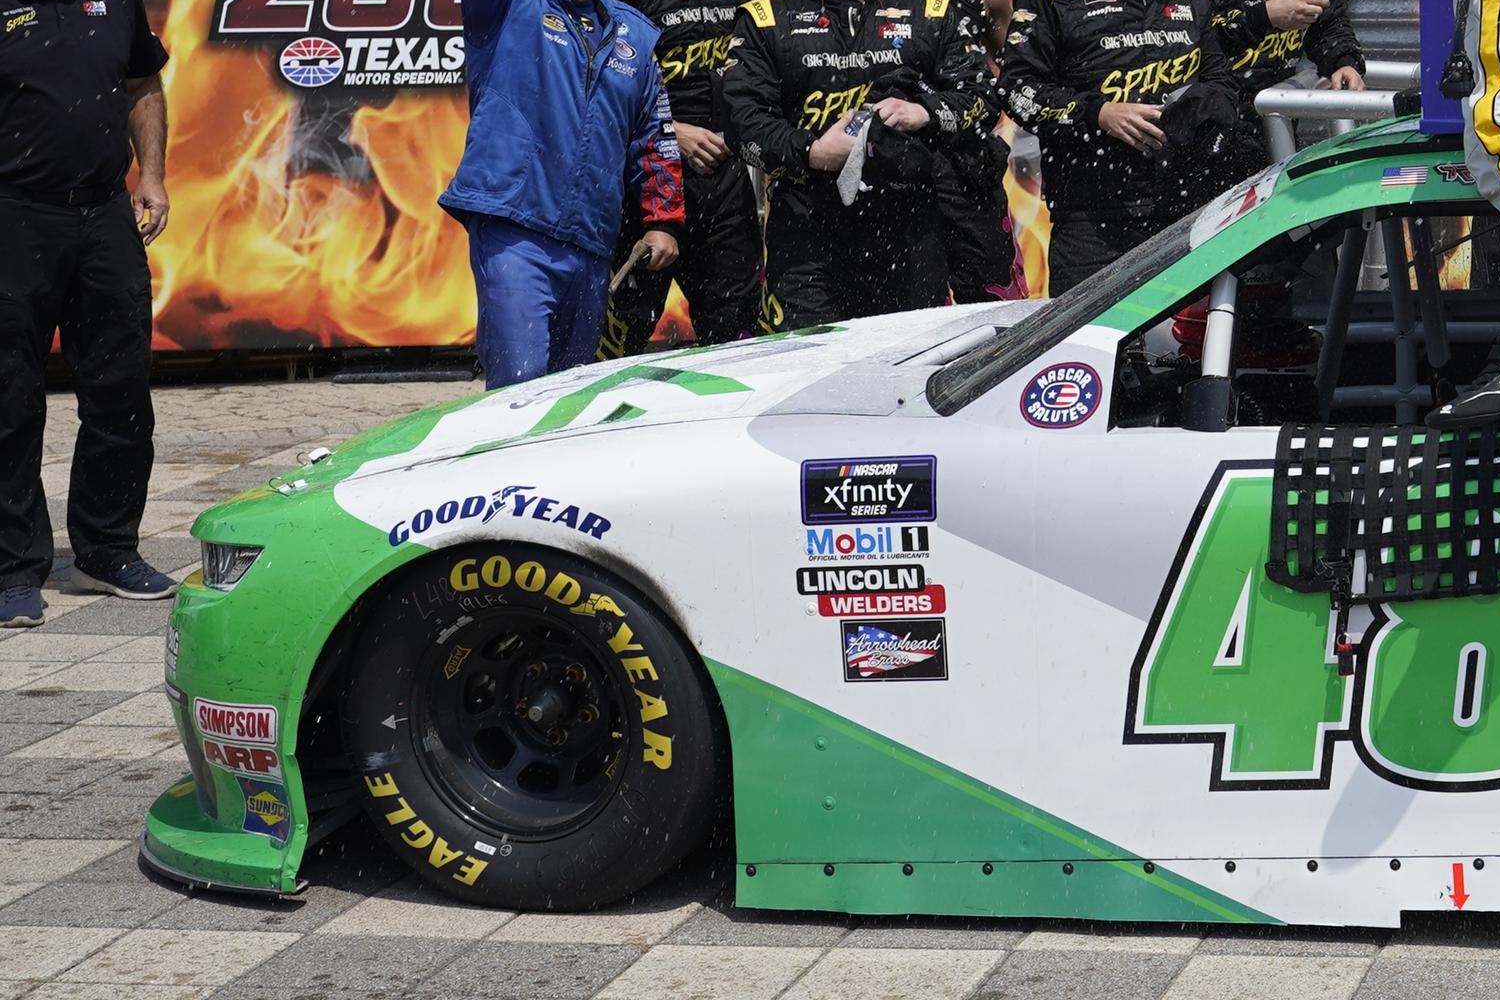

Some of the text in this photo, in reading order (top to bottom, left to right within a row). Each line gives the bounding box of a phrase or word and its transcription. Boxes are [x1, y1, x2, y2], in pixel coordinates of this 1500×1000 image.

[6, 9, 36, 32] SPIKED
[1100, 35, 1120, 49] BIG
[1119, 30, 1165, 48] MACHINE
[343, 37, 465, 70] TEXAS
[661, 34, 732, 83] SPIKE
[802, 50, 903, 70] BIG MACHINE VODKA
[344, 71, 460, 85] MOTOR SPEEDWAY
[1101, 48, 1201, 104] SPIKED
[1036, 367, 1091, 388] NASCAR
[1027, 402, 1088, 422] SALUTES
[853, 463, 898, 476] NASCAR
[824, 478, 914, 510] xfinity
[851, 504, 887, 516] SERIES
[807, 527, 892, 554] Mobil
[802, 568, 919, 592] LINCOLN
[830, 594, 932, 614] WELDERS
[846, 631, 941, 654] Arrowhead
[867, 650, 911, 667] Brass
[200, 705, 270, 739] SIMPSON
[205, 741, 278, 773] ARP
[247, 797, 288, 820] SUNOCO
[364, 771, 490, 887] EAGLE
